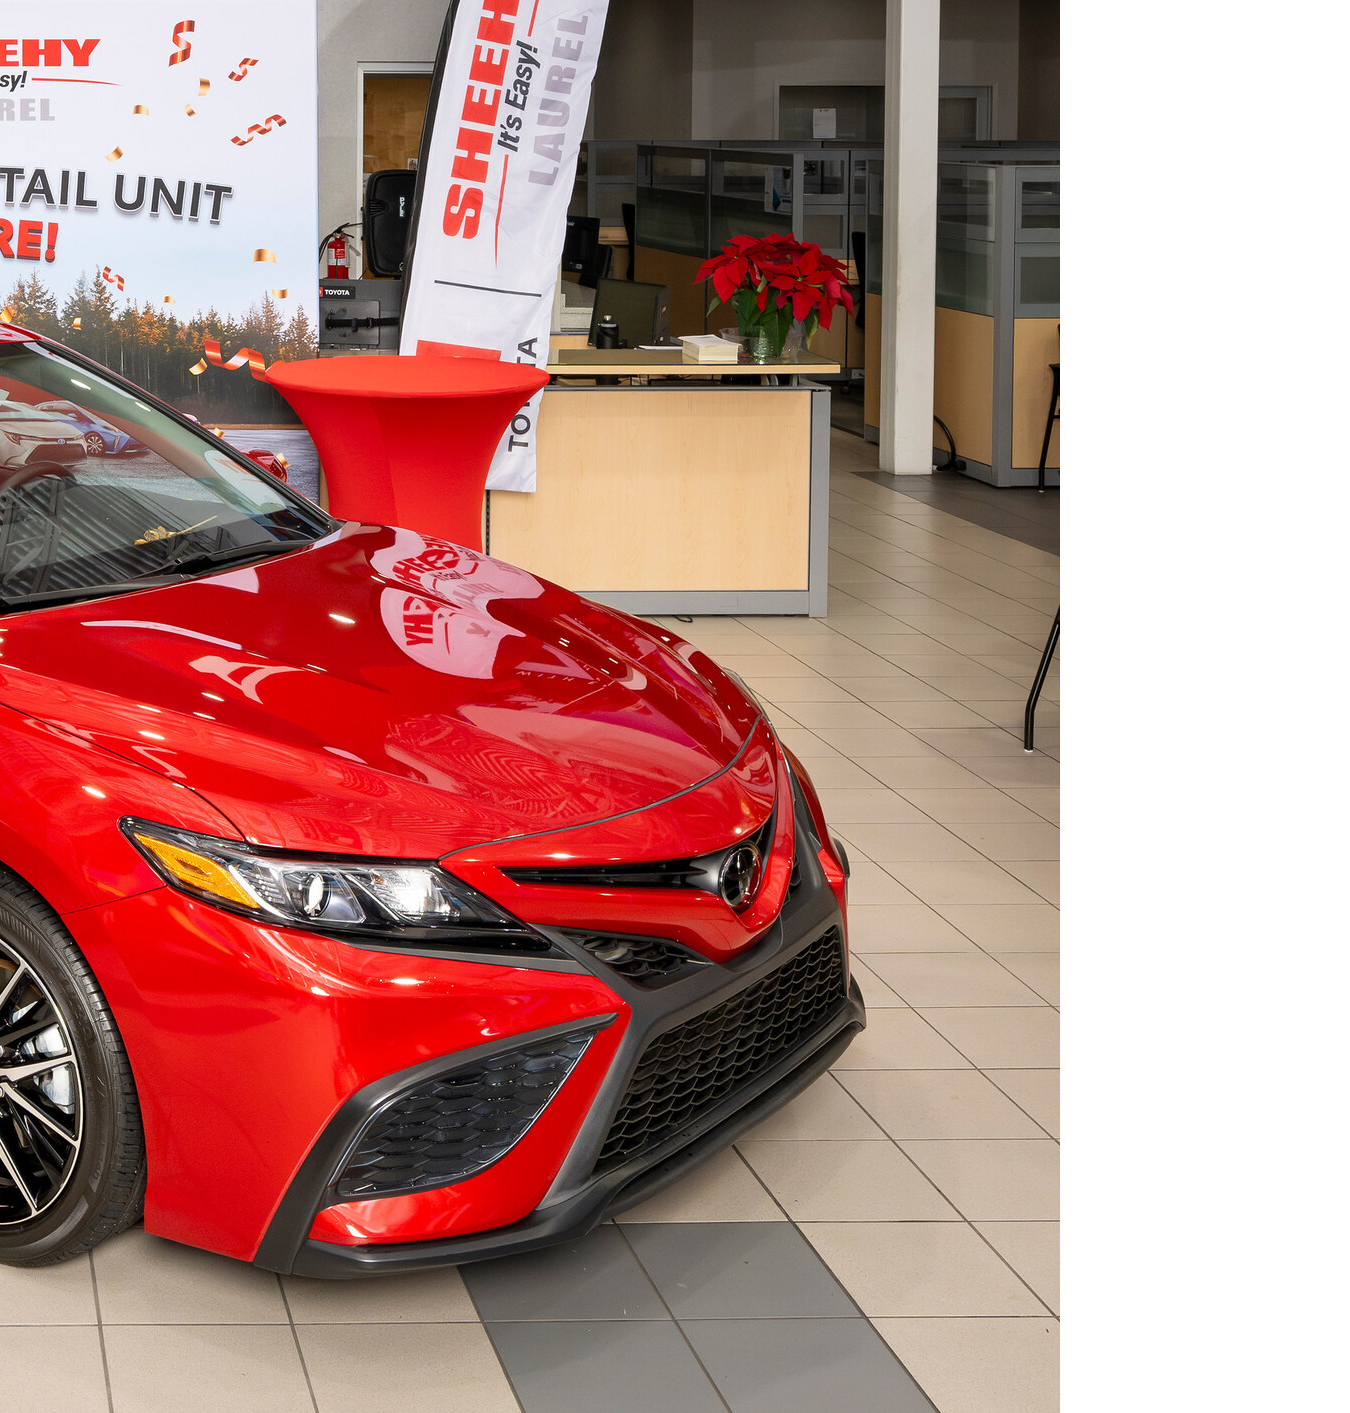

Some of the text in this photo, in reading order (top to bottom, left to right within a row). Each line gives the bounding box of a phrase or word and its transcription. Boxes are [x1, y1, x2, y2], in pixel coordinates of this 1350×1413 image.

[442, 0, 520, 240] SHEEH
[497, 40, 541, 152] It's Easy!
[528, 15, 589, 186] LAUREL
[113, 172, 235, 224] UNIT
[508, 337, 538, 452] TOTA
